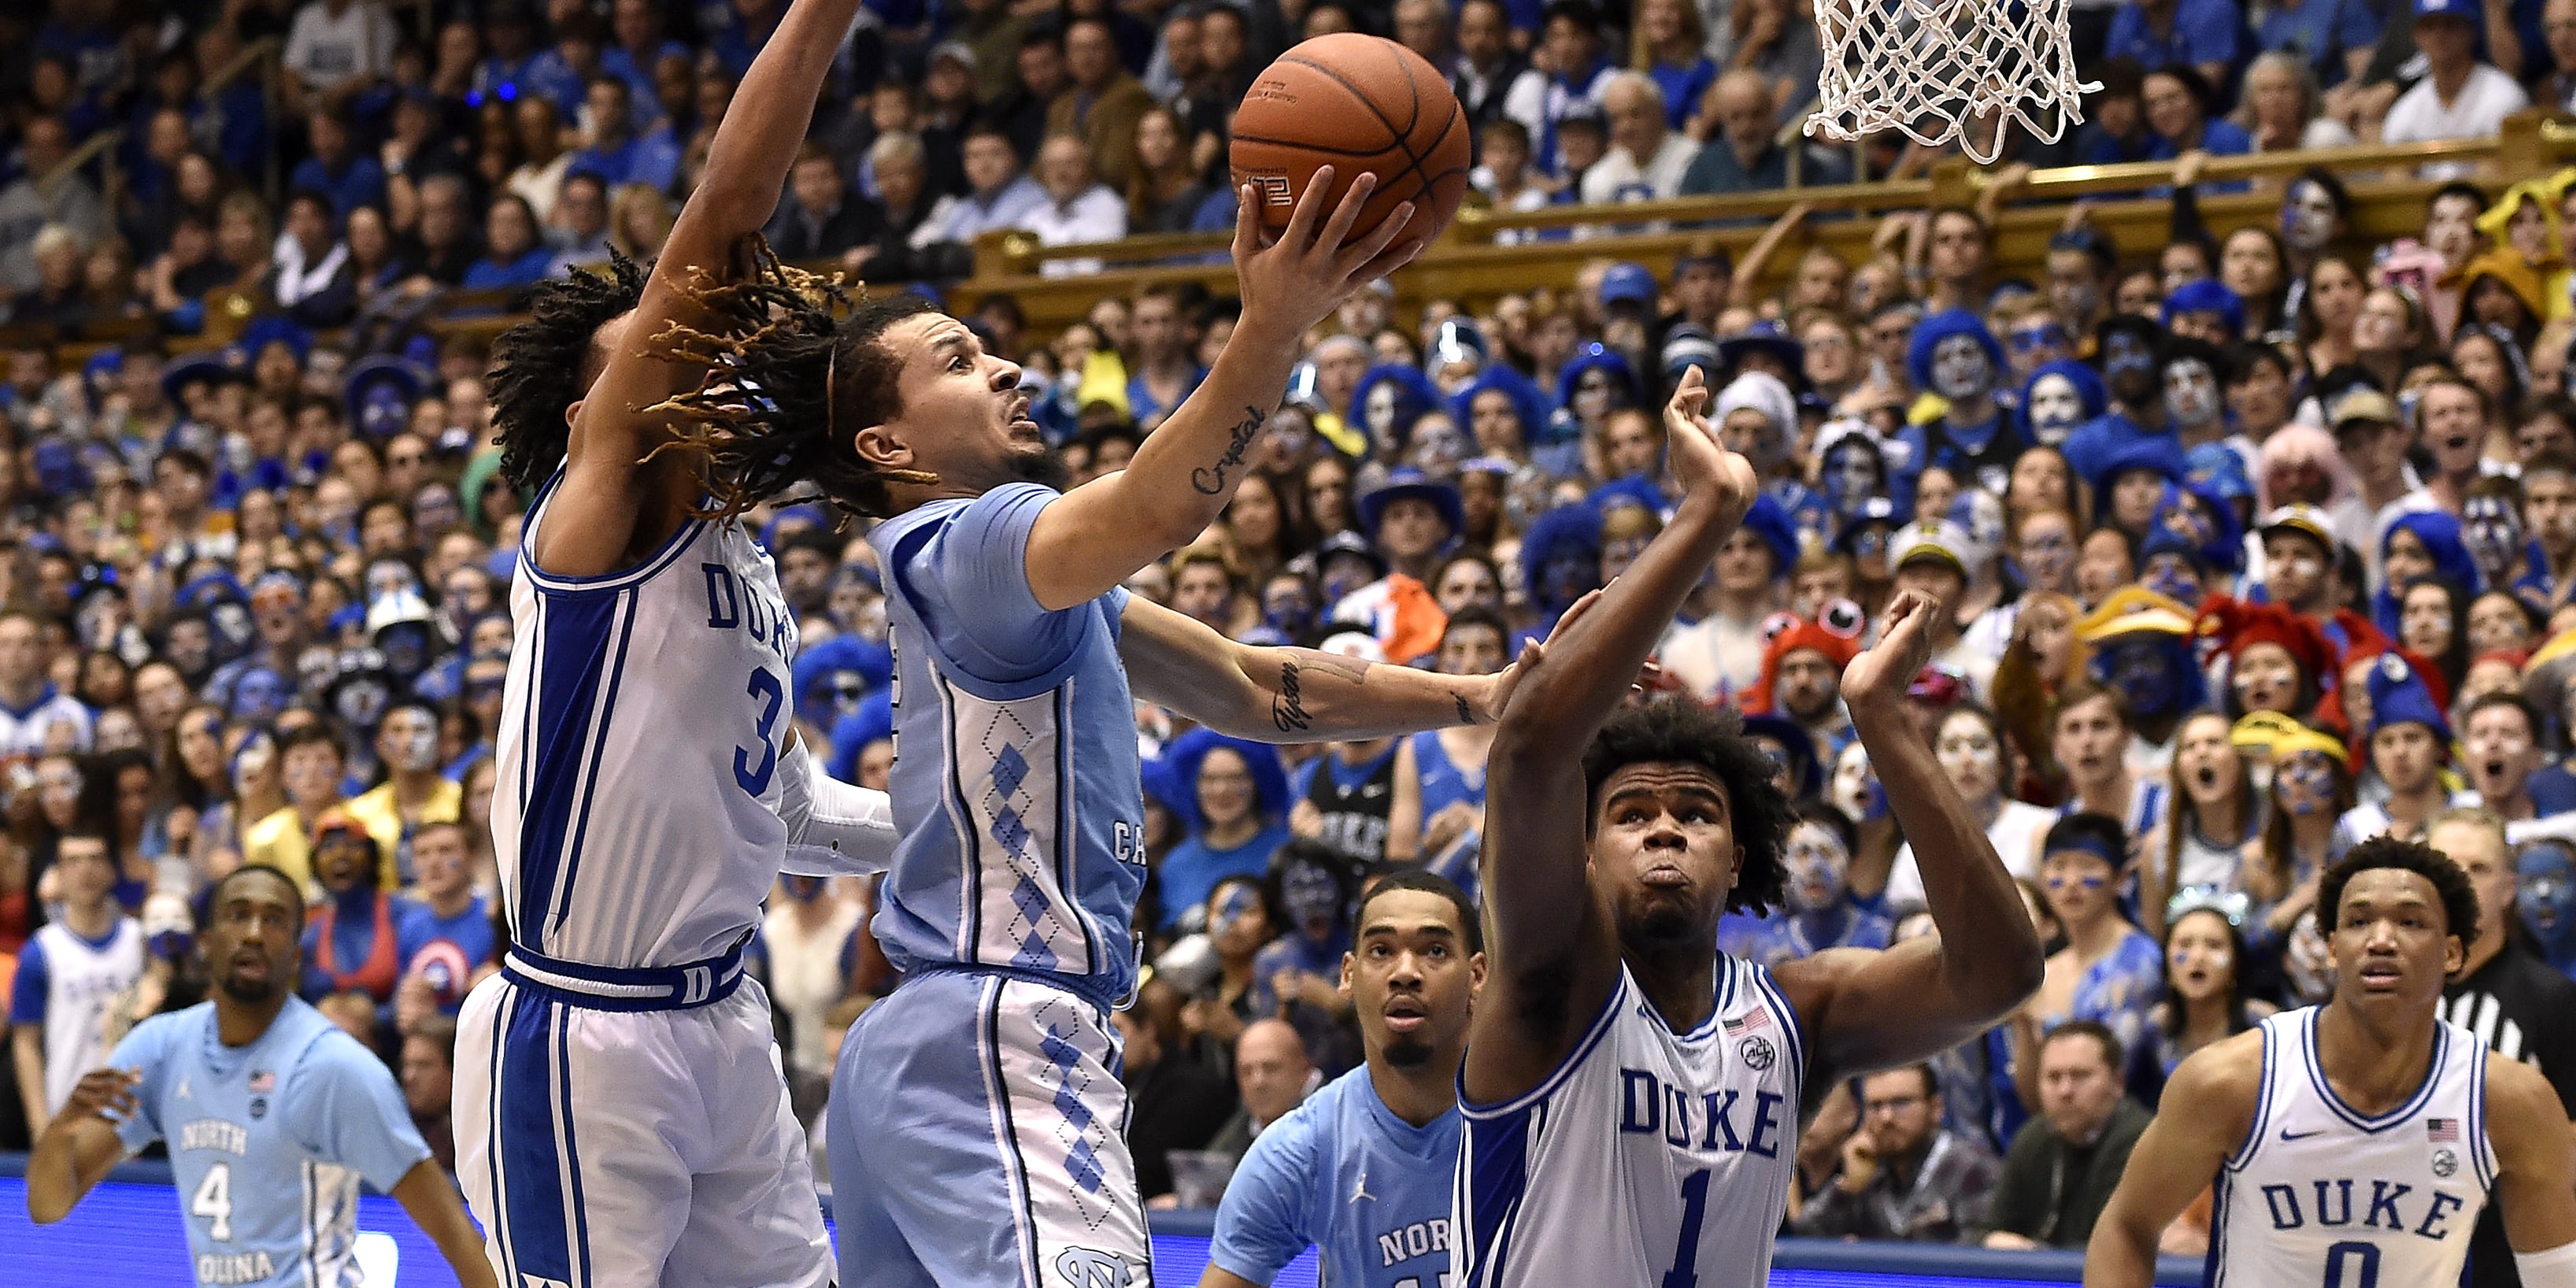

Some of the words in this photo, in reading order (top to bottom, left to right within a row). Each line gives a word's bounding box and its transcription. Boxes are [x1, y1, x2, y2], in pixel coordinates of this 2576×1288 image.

[1191, 405, 1266, 495] Crystal
[733, 666, 783, 798] 3
[1272, 661, 1313, 732] Tyson
[681, 965, 712, 1005] D
[180, 1119, 248, 1158] NORTH
[1619, 1066, 1784, 1160] DUKE
[191, 1159, 232, 1242] 4
[1660, 1168, 1712, 1288] 1
[2260, 1179, 2464, 1242] DUKE
[1378, 1218, 1451, 1268] NOR
